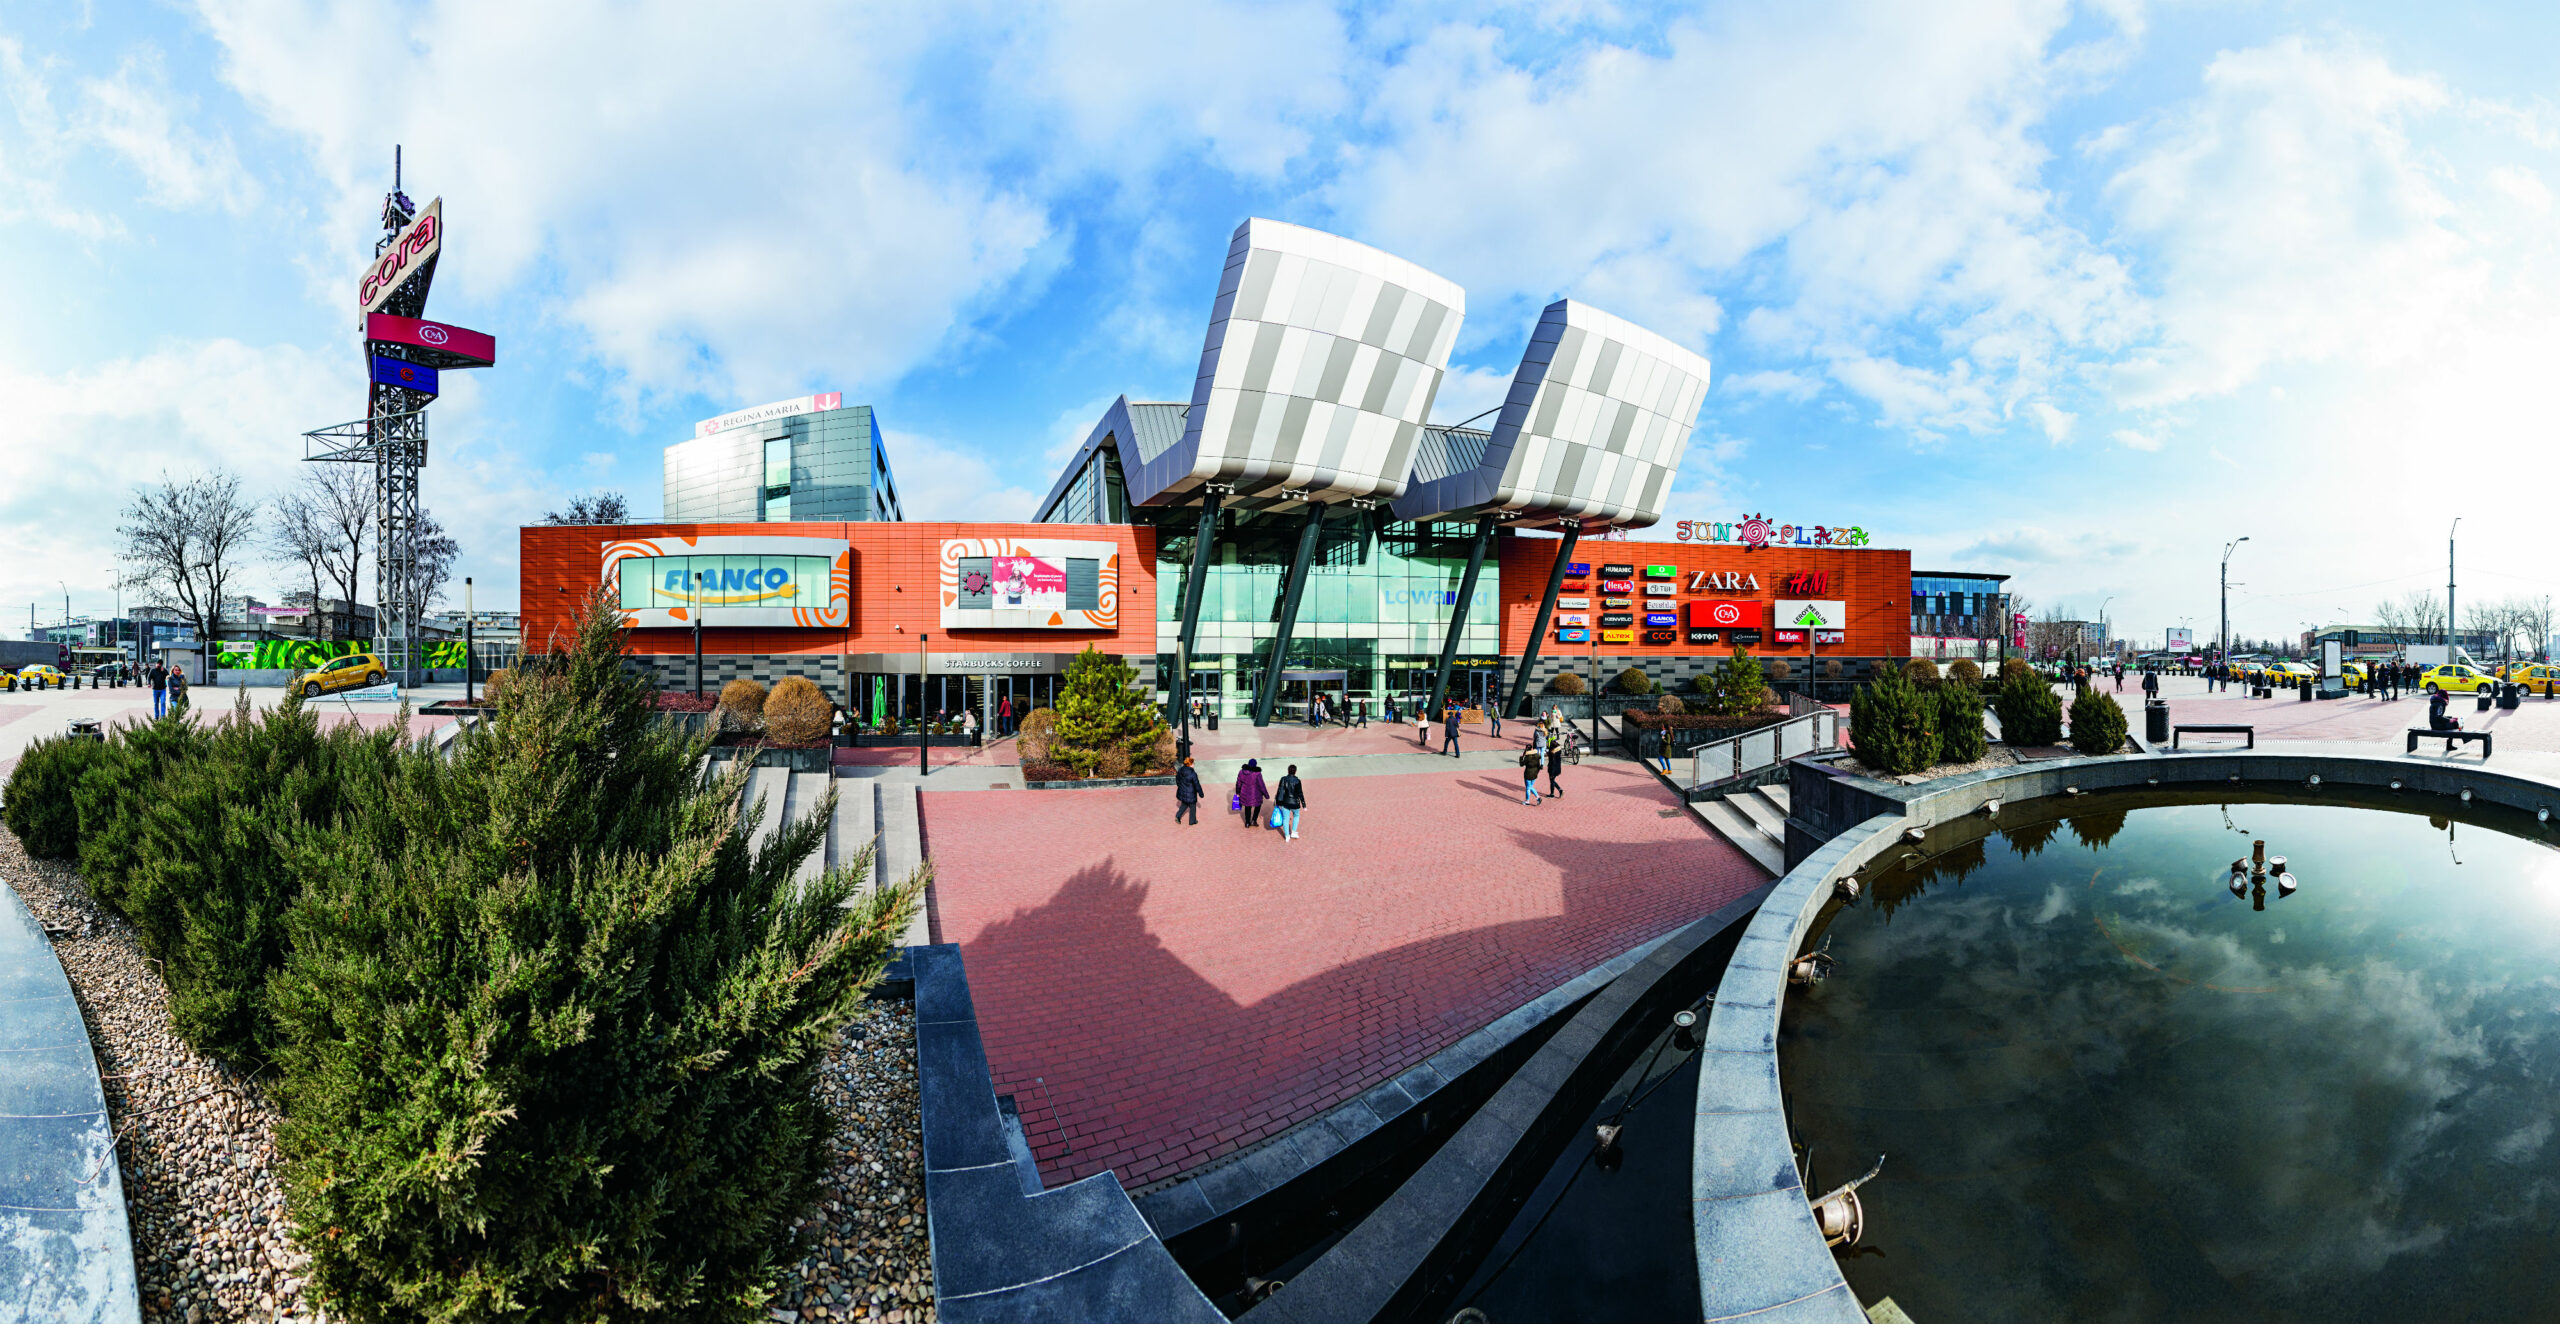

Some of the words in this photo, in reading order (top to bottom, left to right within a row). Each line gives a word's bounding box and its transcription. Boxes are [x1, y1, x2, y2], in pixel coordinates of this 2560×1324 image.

[360, 215, 435, 306] cora
[424, 329, 443, 341] C&A
[723, 411, 761, 427] REGINA
[764, 403, 800, 418] MARIA
[1676, 519, 1732, 542] SUN
[1779, 524, 1870, 546] PLAZA
[664, 567, 789, 591] FLANCO
[1607, 581, 1631, 591] Hervis
[1690, 570, 1760, 590] ZARA
[1789, 569, 1829, 594] H&M
[1718, 609, 1735, 619] C&A
[1793, 607, 1809, 625] LEROY
[1808, 603, 1828, 625] MERLIN
[1652, 632, 1673, 640] CCC
[944, 660, 1004, 668] STARBUCKS
[1006, 660, 1042, 668] COFFEE
